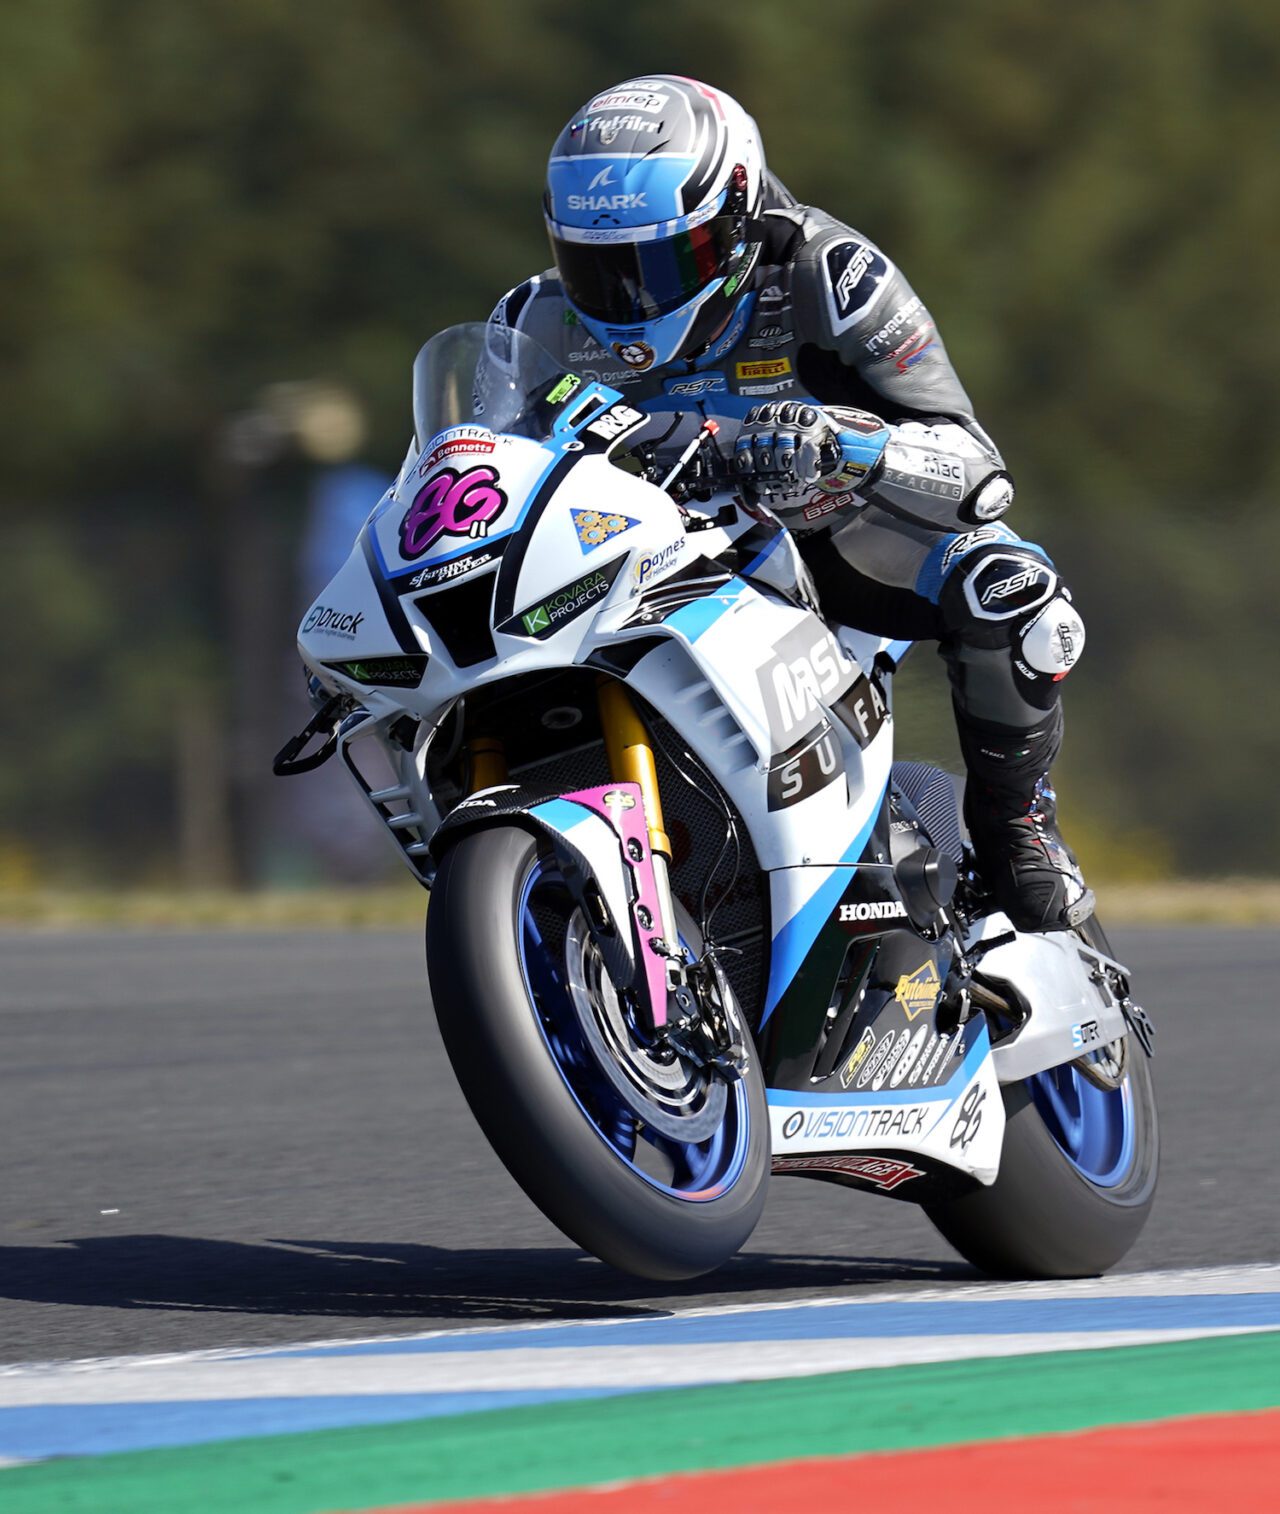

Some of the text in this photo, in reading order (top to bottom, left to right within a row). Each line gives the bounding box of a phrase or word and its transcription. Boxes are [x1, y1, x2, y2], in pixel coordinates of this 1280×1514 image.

[592, 95, 660, 109] elmrep
[567, 192, 648, 212] SHARK
[835, 246, 875, 311] RST
[568, 349, 612, 363] SHAR
[741, 362, 784, 376] PIRELLI
[668, 378, 724, 395] RST
[586, 405, 643, 441] R&G
[437, 443, 493, 457] Bennetts
[806, 493, 852, 520] BSB
[640, 536, 685, 584] Paynes
[545, 572, 606, 613] KOVARA
[981, 567, 1043, 605] RST
[549, 580, 610, 622] PROJECTS
[317, 608, 364, 634] Druck
[838, 901, 908, 922] HONDA
[804, 1107, 930, 1138] VISIONTRACK
[950, 1081, 987, 1149] 86
